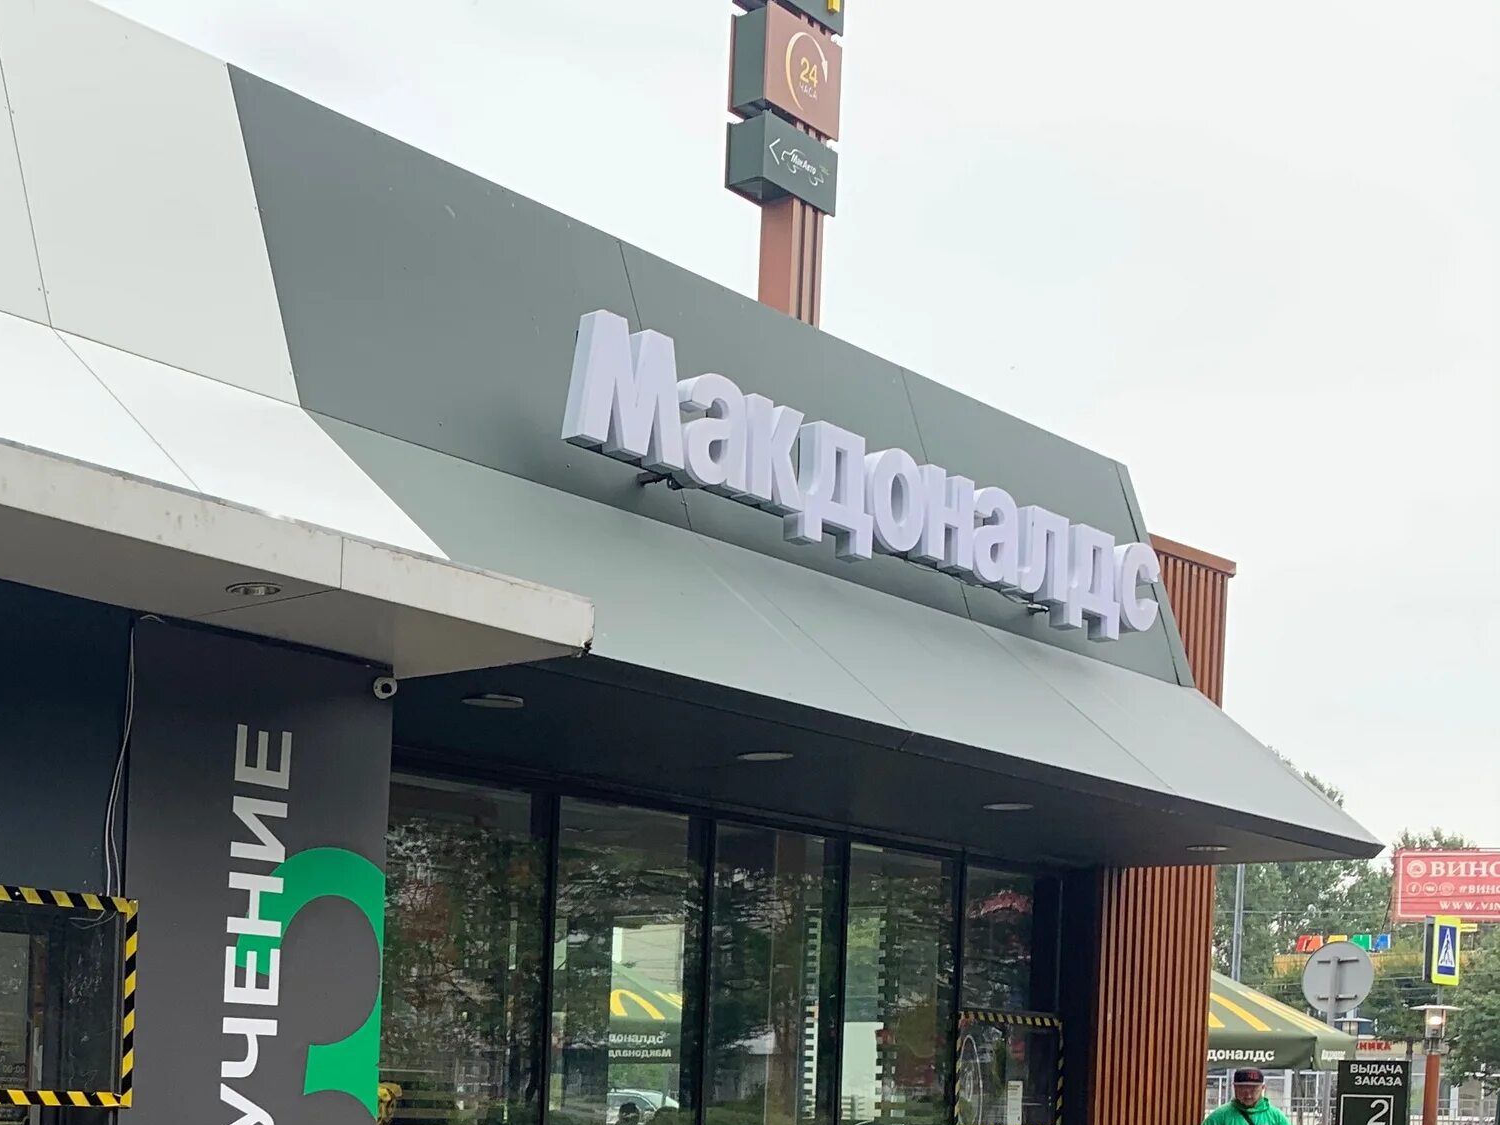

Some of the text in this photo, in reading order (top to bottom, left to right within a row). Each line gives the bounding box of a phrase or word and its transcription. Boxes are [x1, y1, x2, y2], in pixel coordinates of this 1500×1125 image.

[800, 57, 818, 88] 24
[561, 309, 1160, 642] Макдоналдс
[1350, 1063, 1403, 1075] ВЫДАЧА
[1354, 1075, 1403, 1087] ЗАКАЗА
